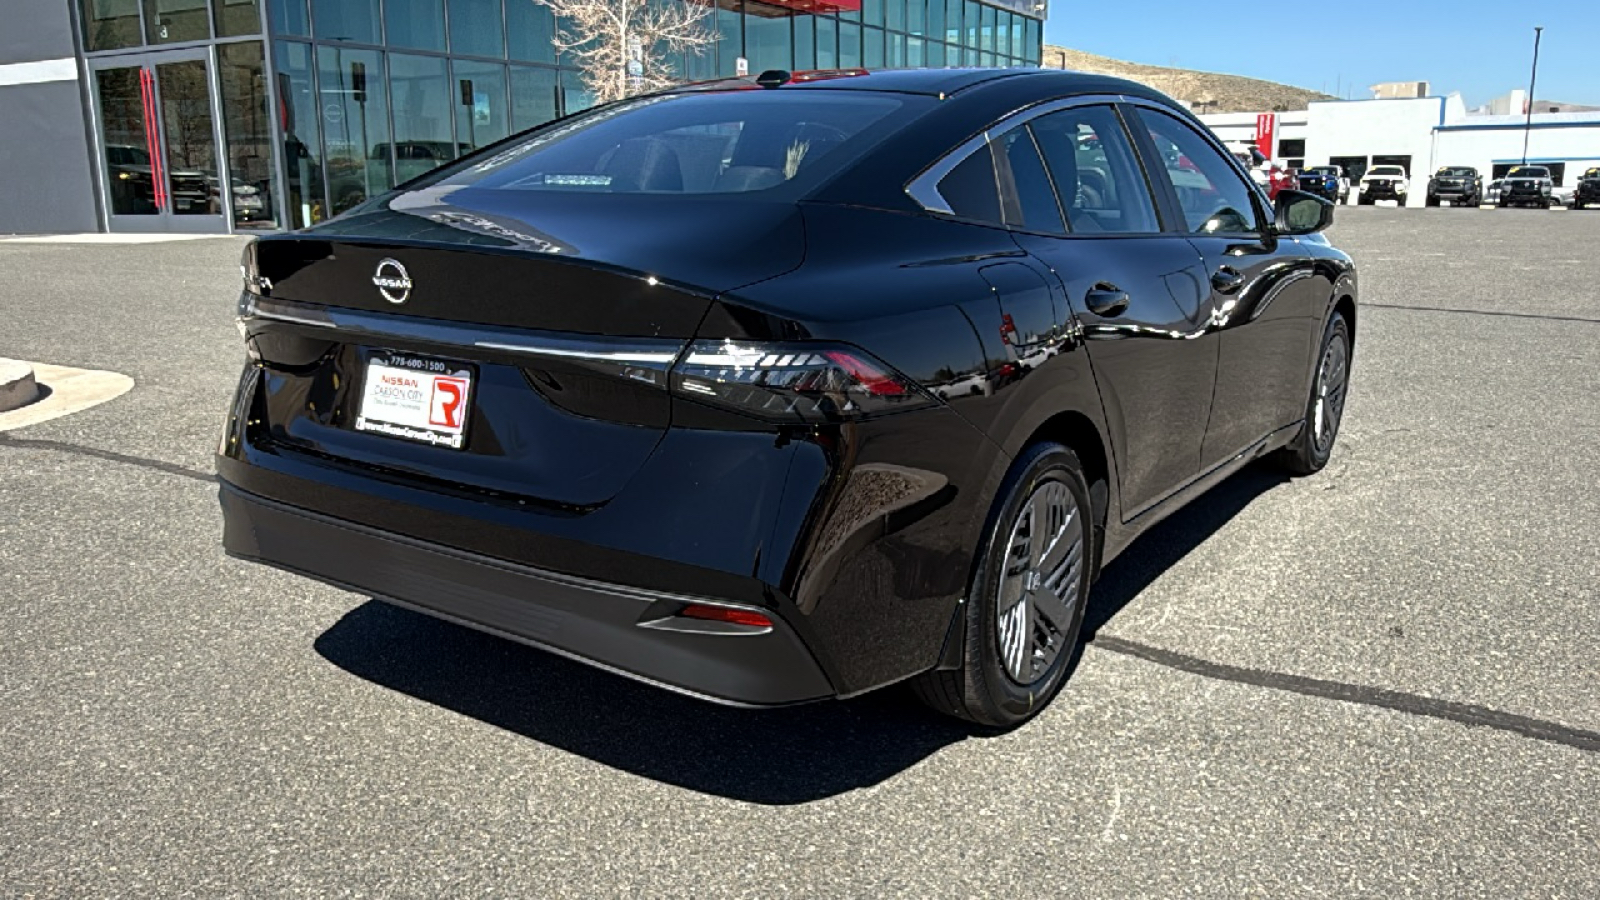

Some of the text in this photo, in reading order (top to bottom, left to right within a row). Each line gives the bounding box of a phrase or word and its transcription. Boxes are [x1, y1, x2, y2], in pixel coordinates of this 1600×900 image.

[372, 275, 412, 288] NISSAN
[391, 355, 445, 371] 775-600-1500
[382, 374, 419, 388] NISSAN
[374, 384, 423, 400] CARSON CITY
